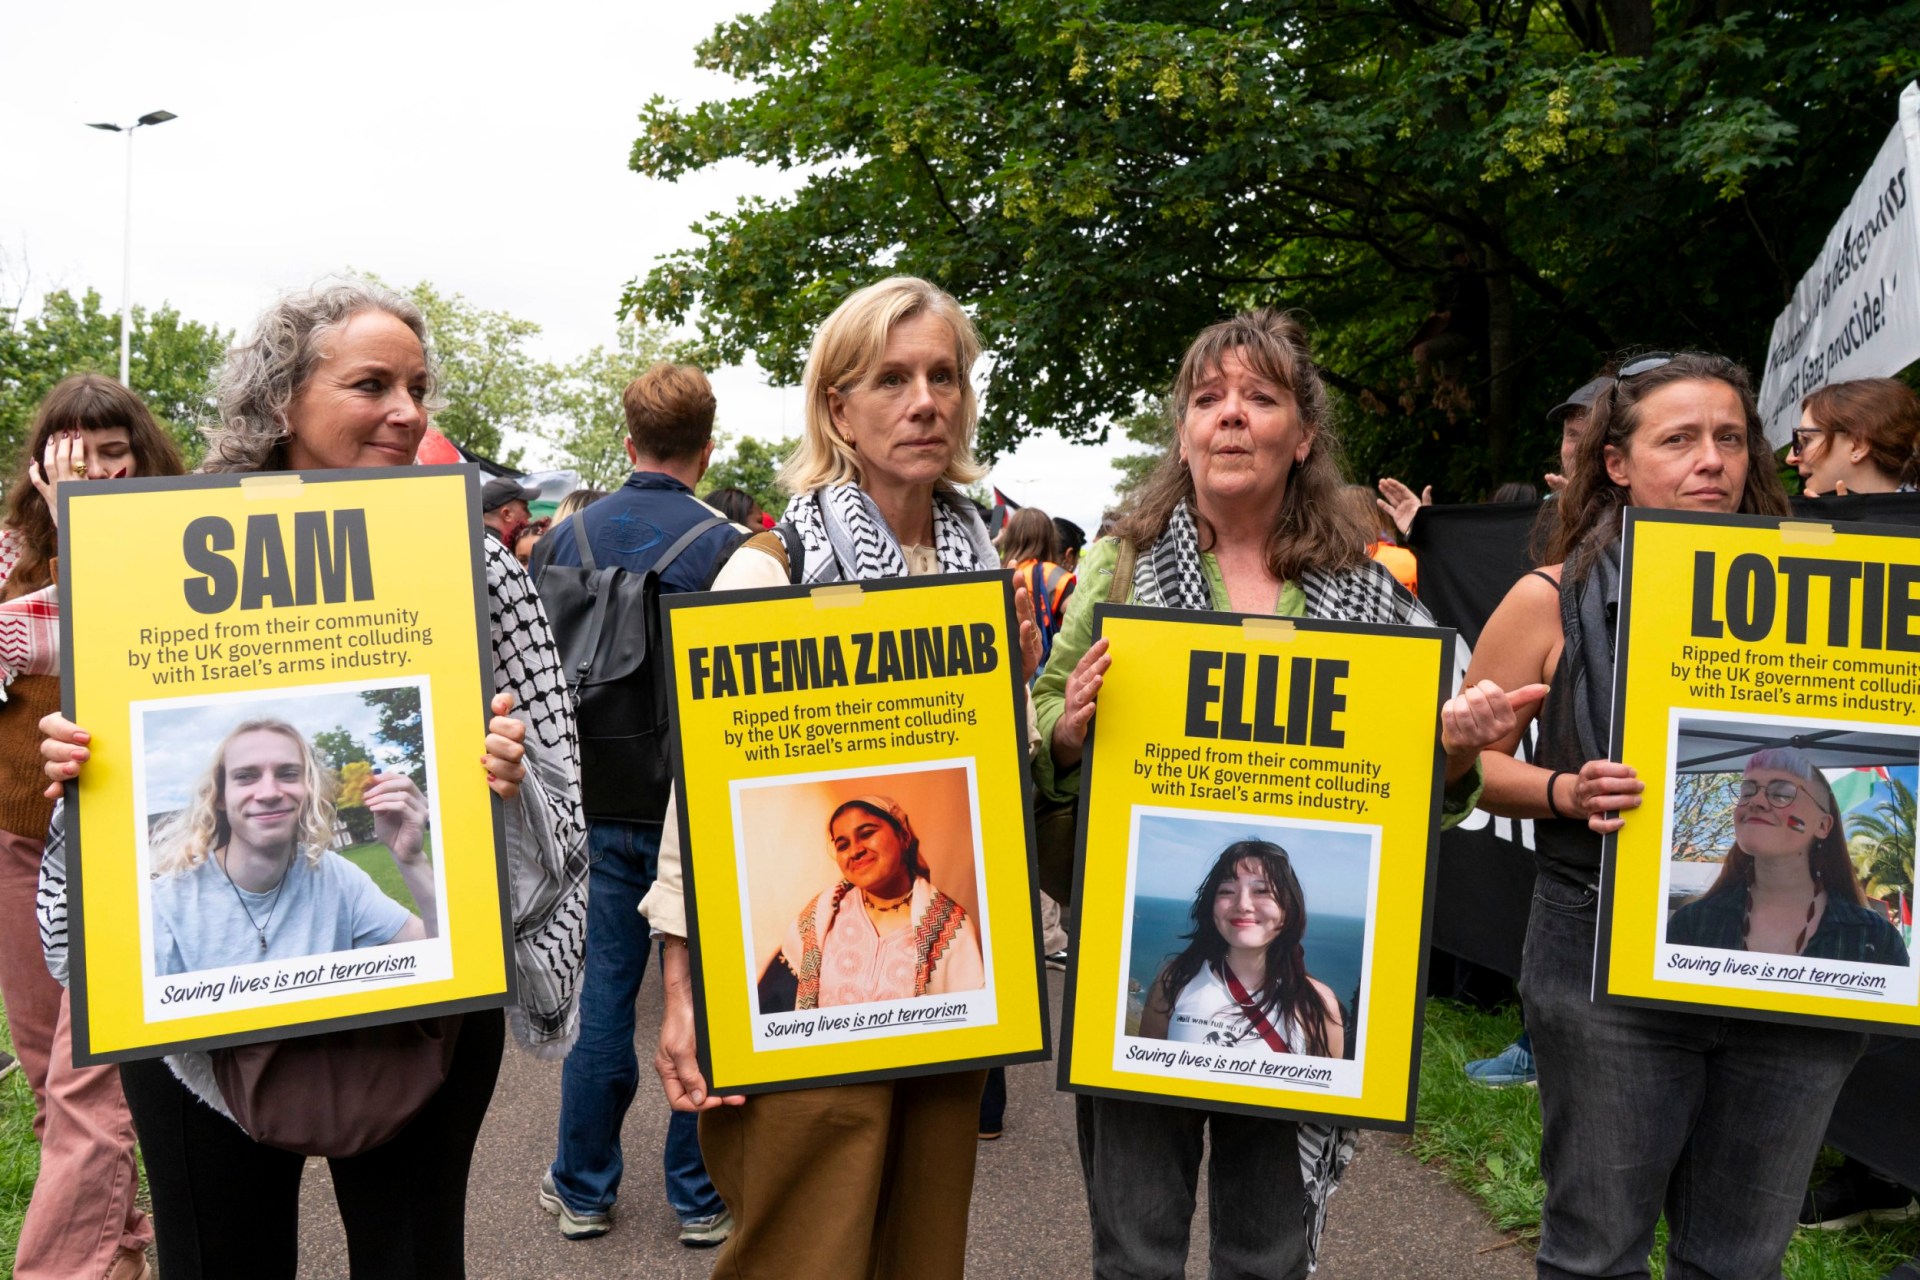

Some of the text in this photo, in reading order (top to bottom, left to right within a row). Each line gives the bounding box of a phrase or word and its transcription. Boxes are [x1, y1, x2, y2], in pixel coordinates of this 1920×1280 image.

[1802, 353, 1825, 394] Gaza
[183, 508, 374, 614] SAM
[1691, 551, 1920, 653] LOTTIE
[140, 609, 419, 647] Ripped from their community
[129, 627, 433, 669] by the UK government colluding
[689, 622, 998, 700] FATEMA ZAINAB
[1682, 646, 1920, 677] Ripped from their communit
[152, 649, 412, 685] with Israel’s arms industry.
[1672, 662, 1920, 695] by the UK government colludi
[733, 691, 964, 727] Ripped from their community
[1185, 649, 1349, 748] ELLIE
[1690, 683, 1916, 716] with Israel’s arms industry.
[725, 709, 977, 747] by the UK government colluding
[745, 730, 959, 762] with Israel’s arms industry.
[1134, 760, 1390, 798] by the UK government colluding
[1145, 743, 1381, 778] Ripped from their community
[1151, 781, 1369, 814] with Israel’s arms industry.
[161, 955, 417, 1005] Saving lives is not terrorism.
[1667, 953, 1887, 989] Saving lives is not terrorism.
[765, 1001, 968, 1038] Saving lives is not terrorism.
[1126, 1045, 1332, 1081] Saving lives is not terrorism.
